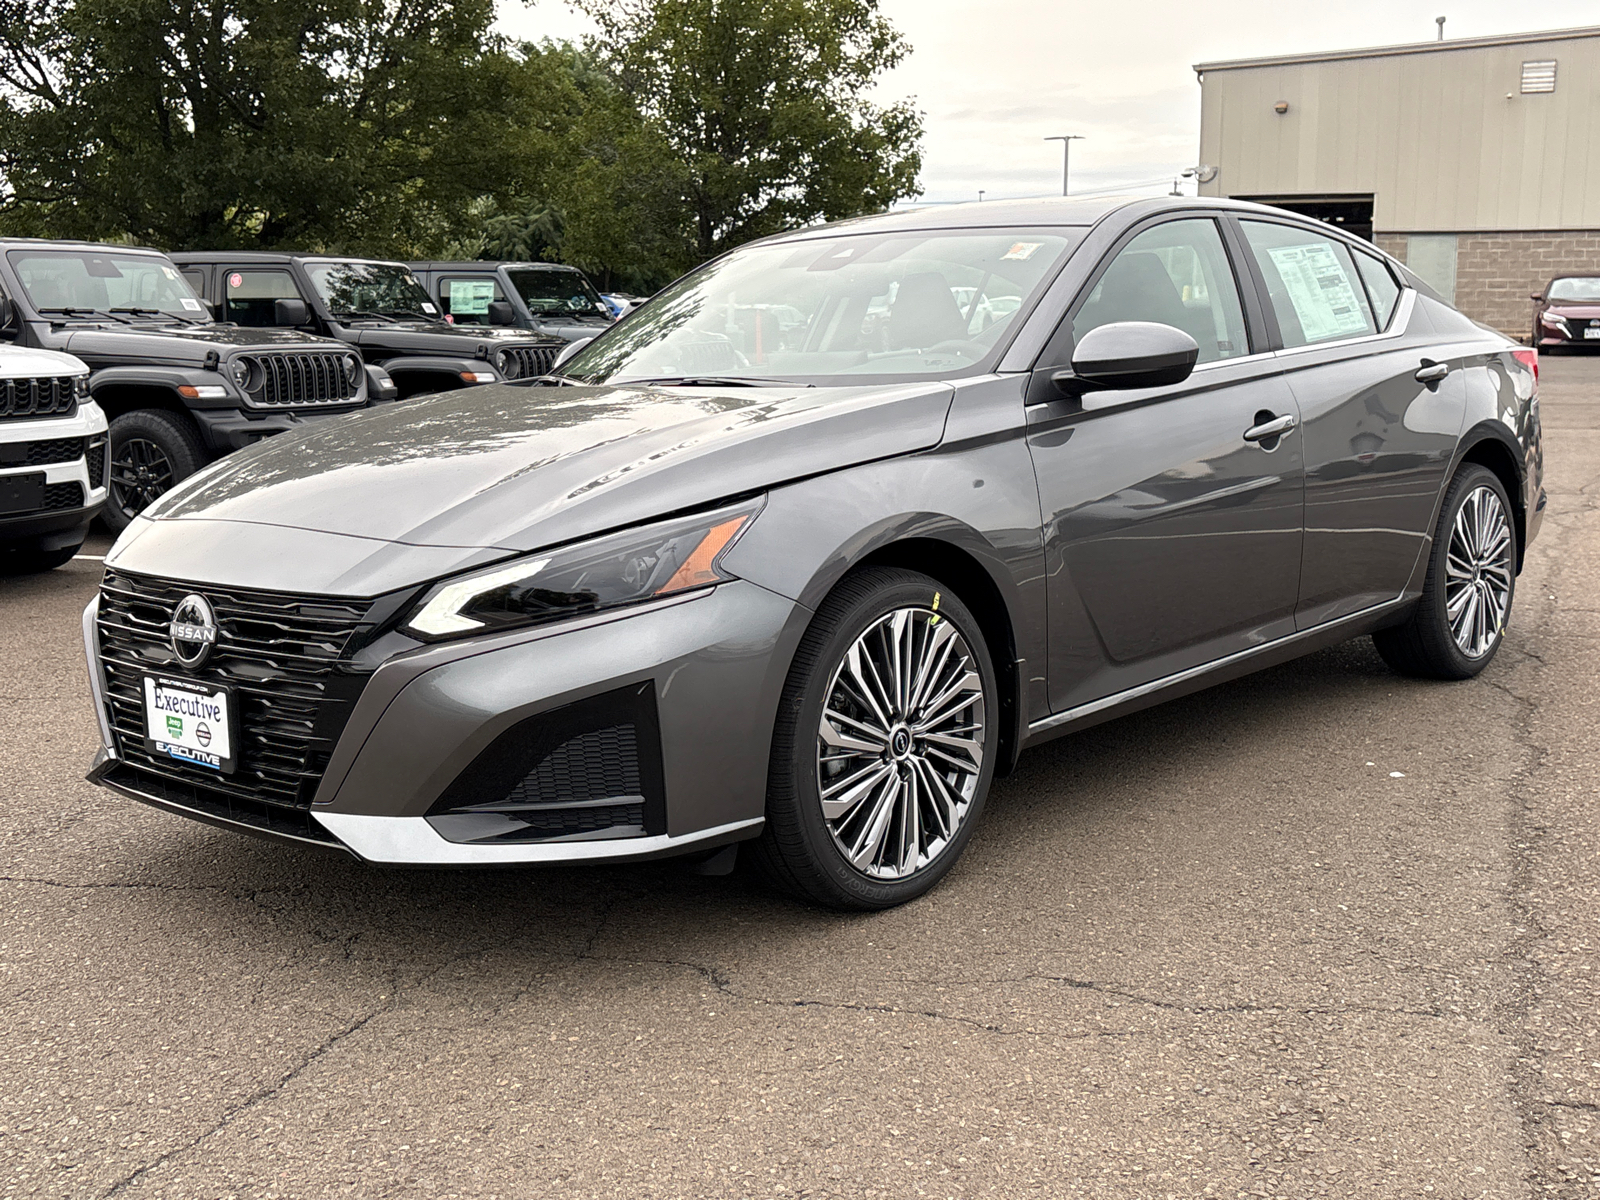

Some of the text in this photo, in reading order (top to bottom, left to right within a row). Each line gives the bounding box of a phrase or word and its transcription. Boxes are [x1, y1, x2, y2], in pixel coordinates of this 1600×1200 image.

[171, 624, 214, 640] NISSAN
[154, 686, 221, 722] Executive
[156, 742, 220, 766] EXECUTIVE
[836, 867, 848, 878] GT
